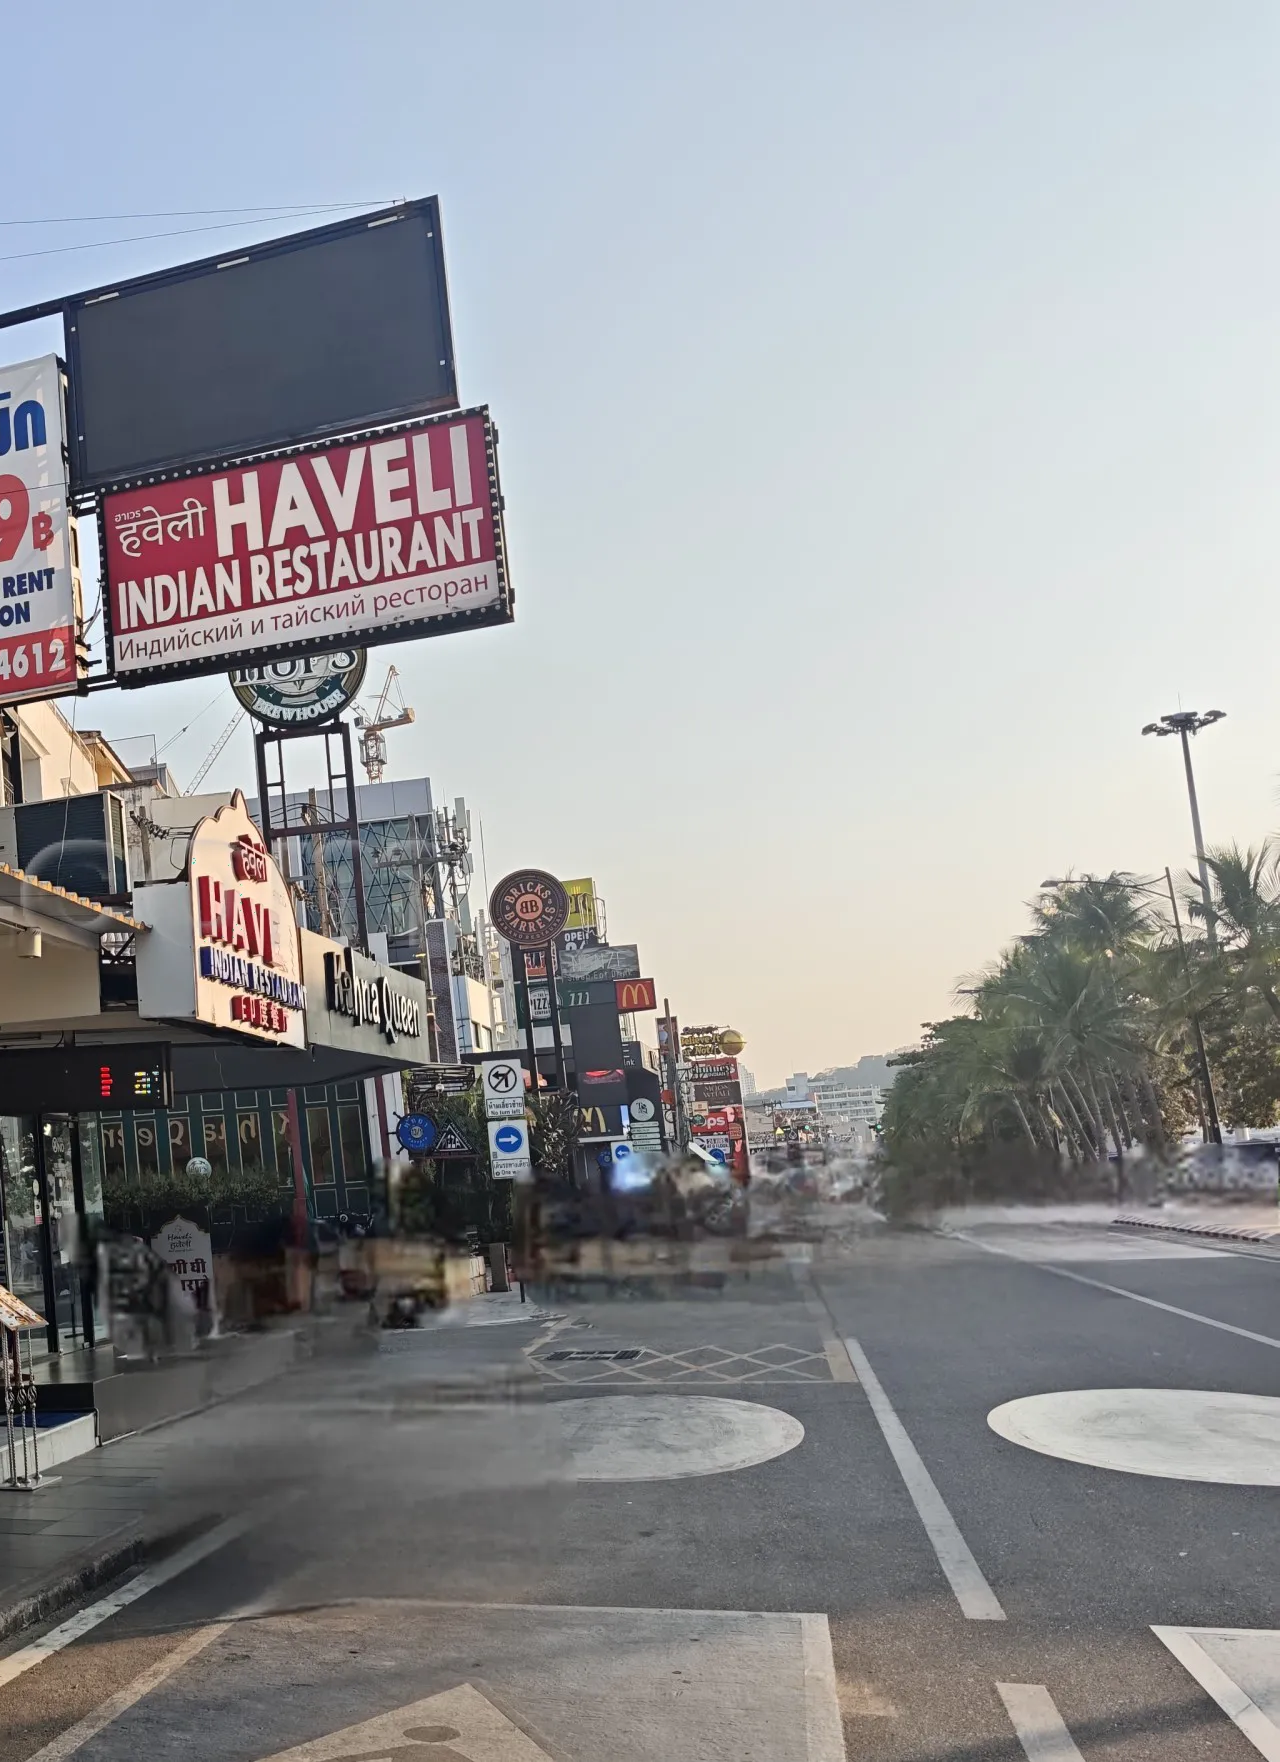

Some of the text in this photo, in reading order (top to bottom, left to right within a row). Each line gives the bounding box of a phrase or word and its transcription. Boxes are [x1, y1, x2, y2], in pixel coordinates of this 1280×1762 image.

[212, 424, 473, 557] HAVELI
[115, 498, 207, 557] हवेली
[3, 568, 55, 599] RENT
[118, 508, 484, 630] INDIAN RESTAURANT
[118, 573, 489, 662] Индийский и тайский ресторан
[252, 688, 347, 721] BREWHOUSE
[504, 881, 552, 904] BRICKS
[504, 906, 556, 933] BARRELS
[199, 946, 250, 989] INDIAN
[377, 976, 421, 1044] Queen
[167, 1232, 192, 1241] Haveli
